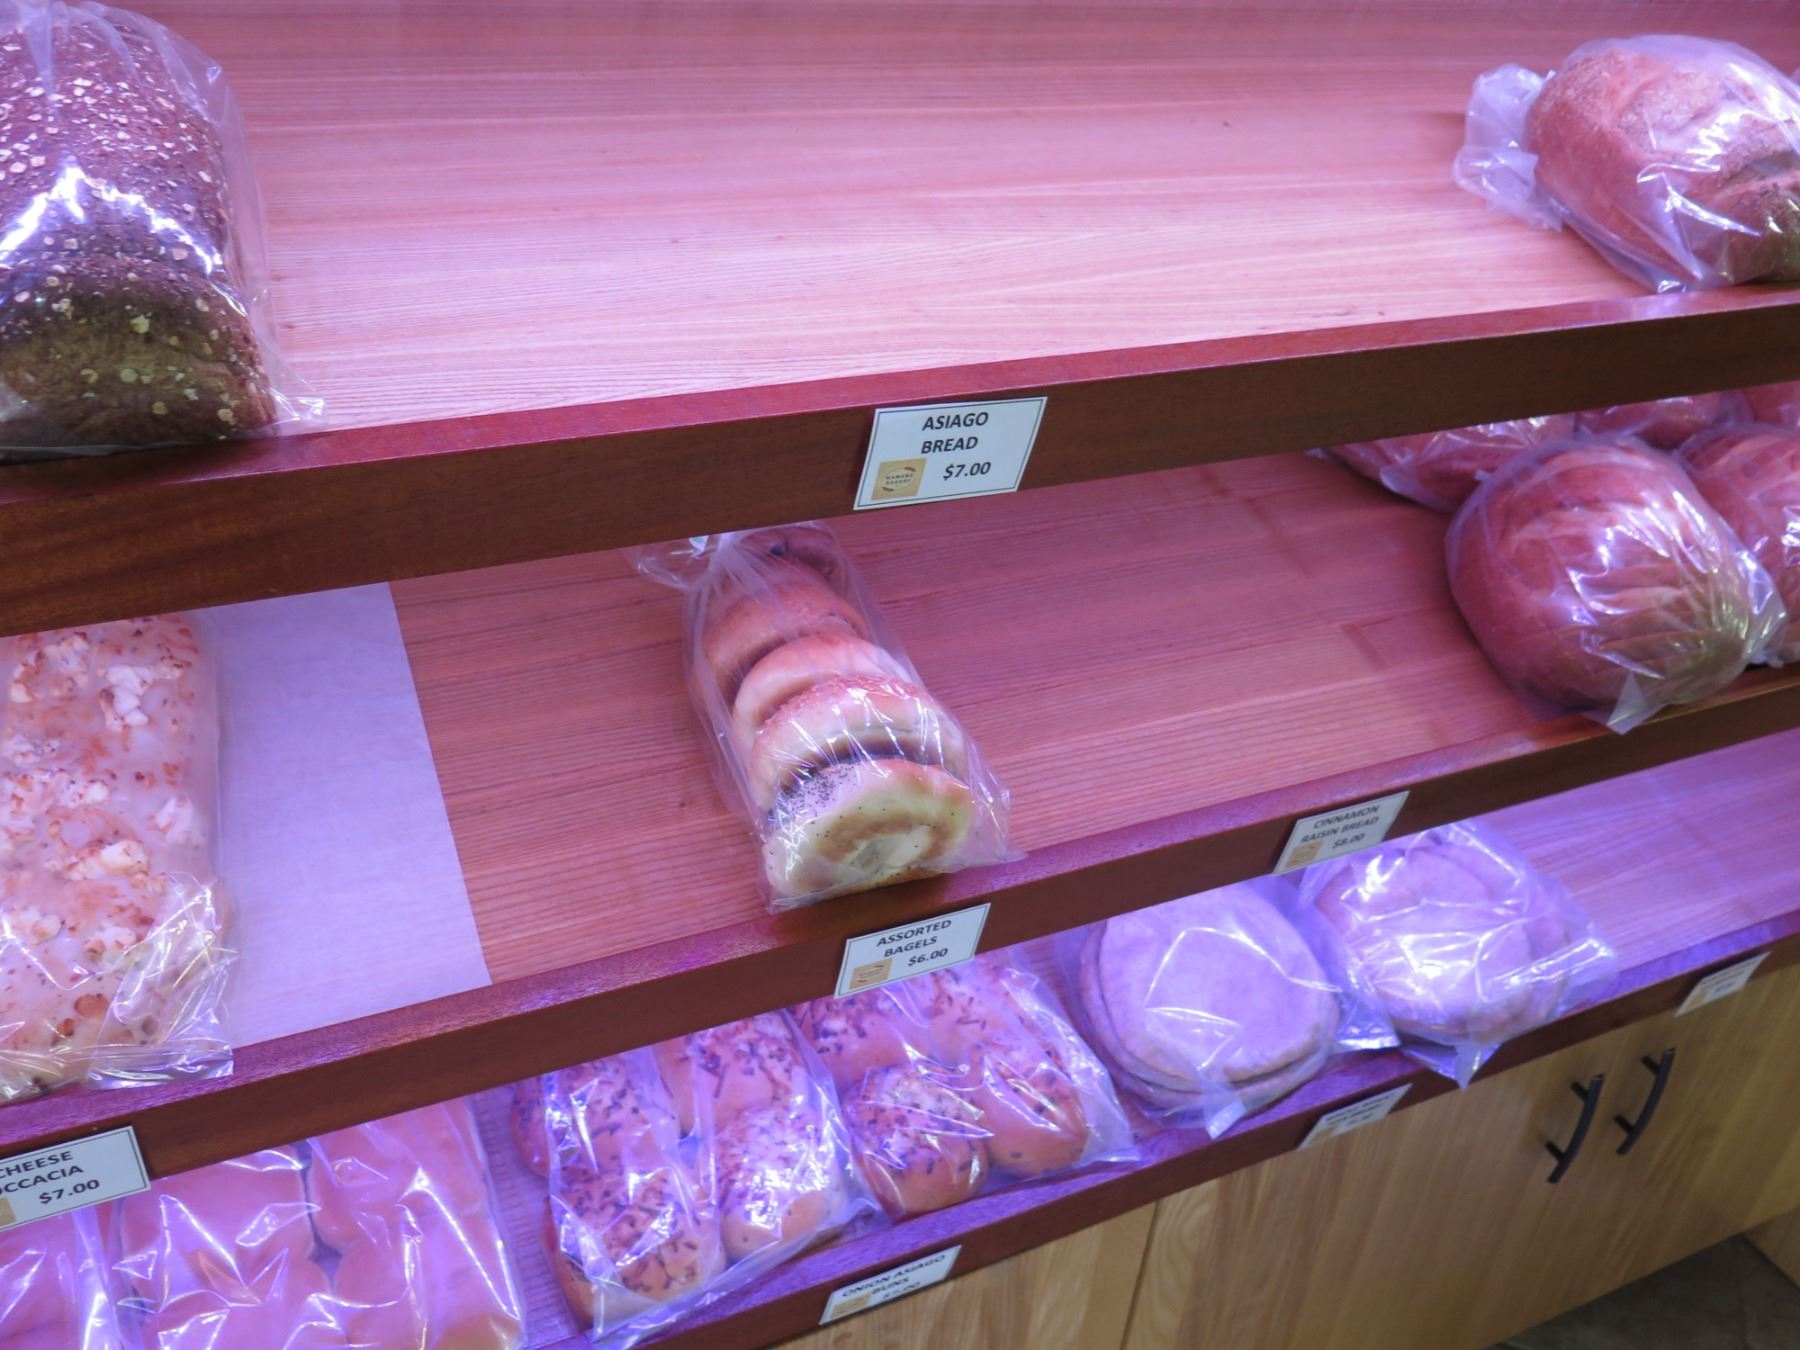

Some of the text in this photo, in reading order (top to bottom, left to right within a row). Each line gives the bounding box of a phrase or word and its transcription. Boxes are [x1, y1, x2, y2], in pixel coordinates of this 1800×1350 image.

[922, 411, 989, 431] ASIAGO
[920, 436, 978, 454] BREAD
[942, 461, 991, 481] $7.00
[1313, 805, 1379, 829] CINNAMON
[1301, 816, 1379, 844] RAISIN BREAD
[876, 919, 952, 947] ASSORTED
[884, 936, 938, 957] BAGELS
[908, 948, 948, 967] $6.00
[0, 1165, 84, 1195] CCACIA
[39, 1179, 100, 1205] $7.00
